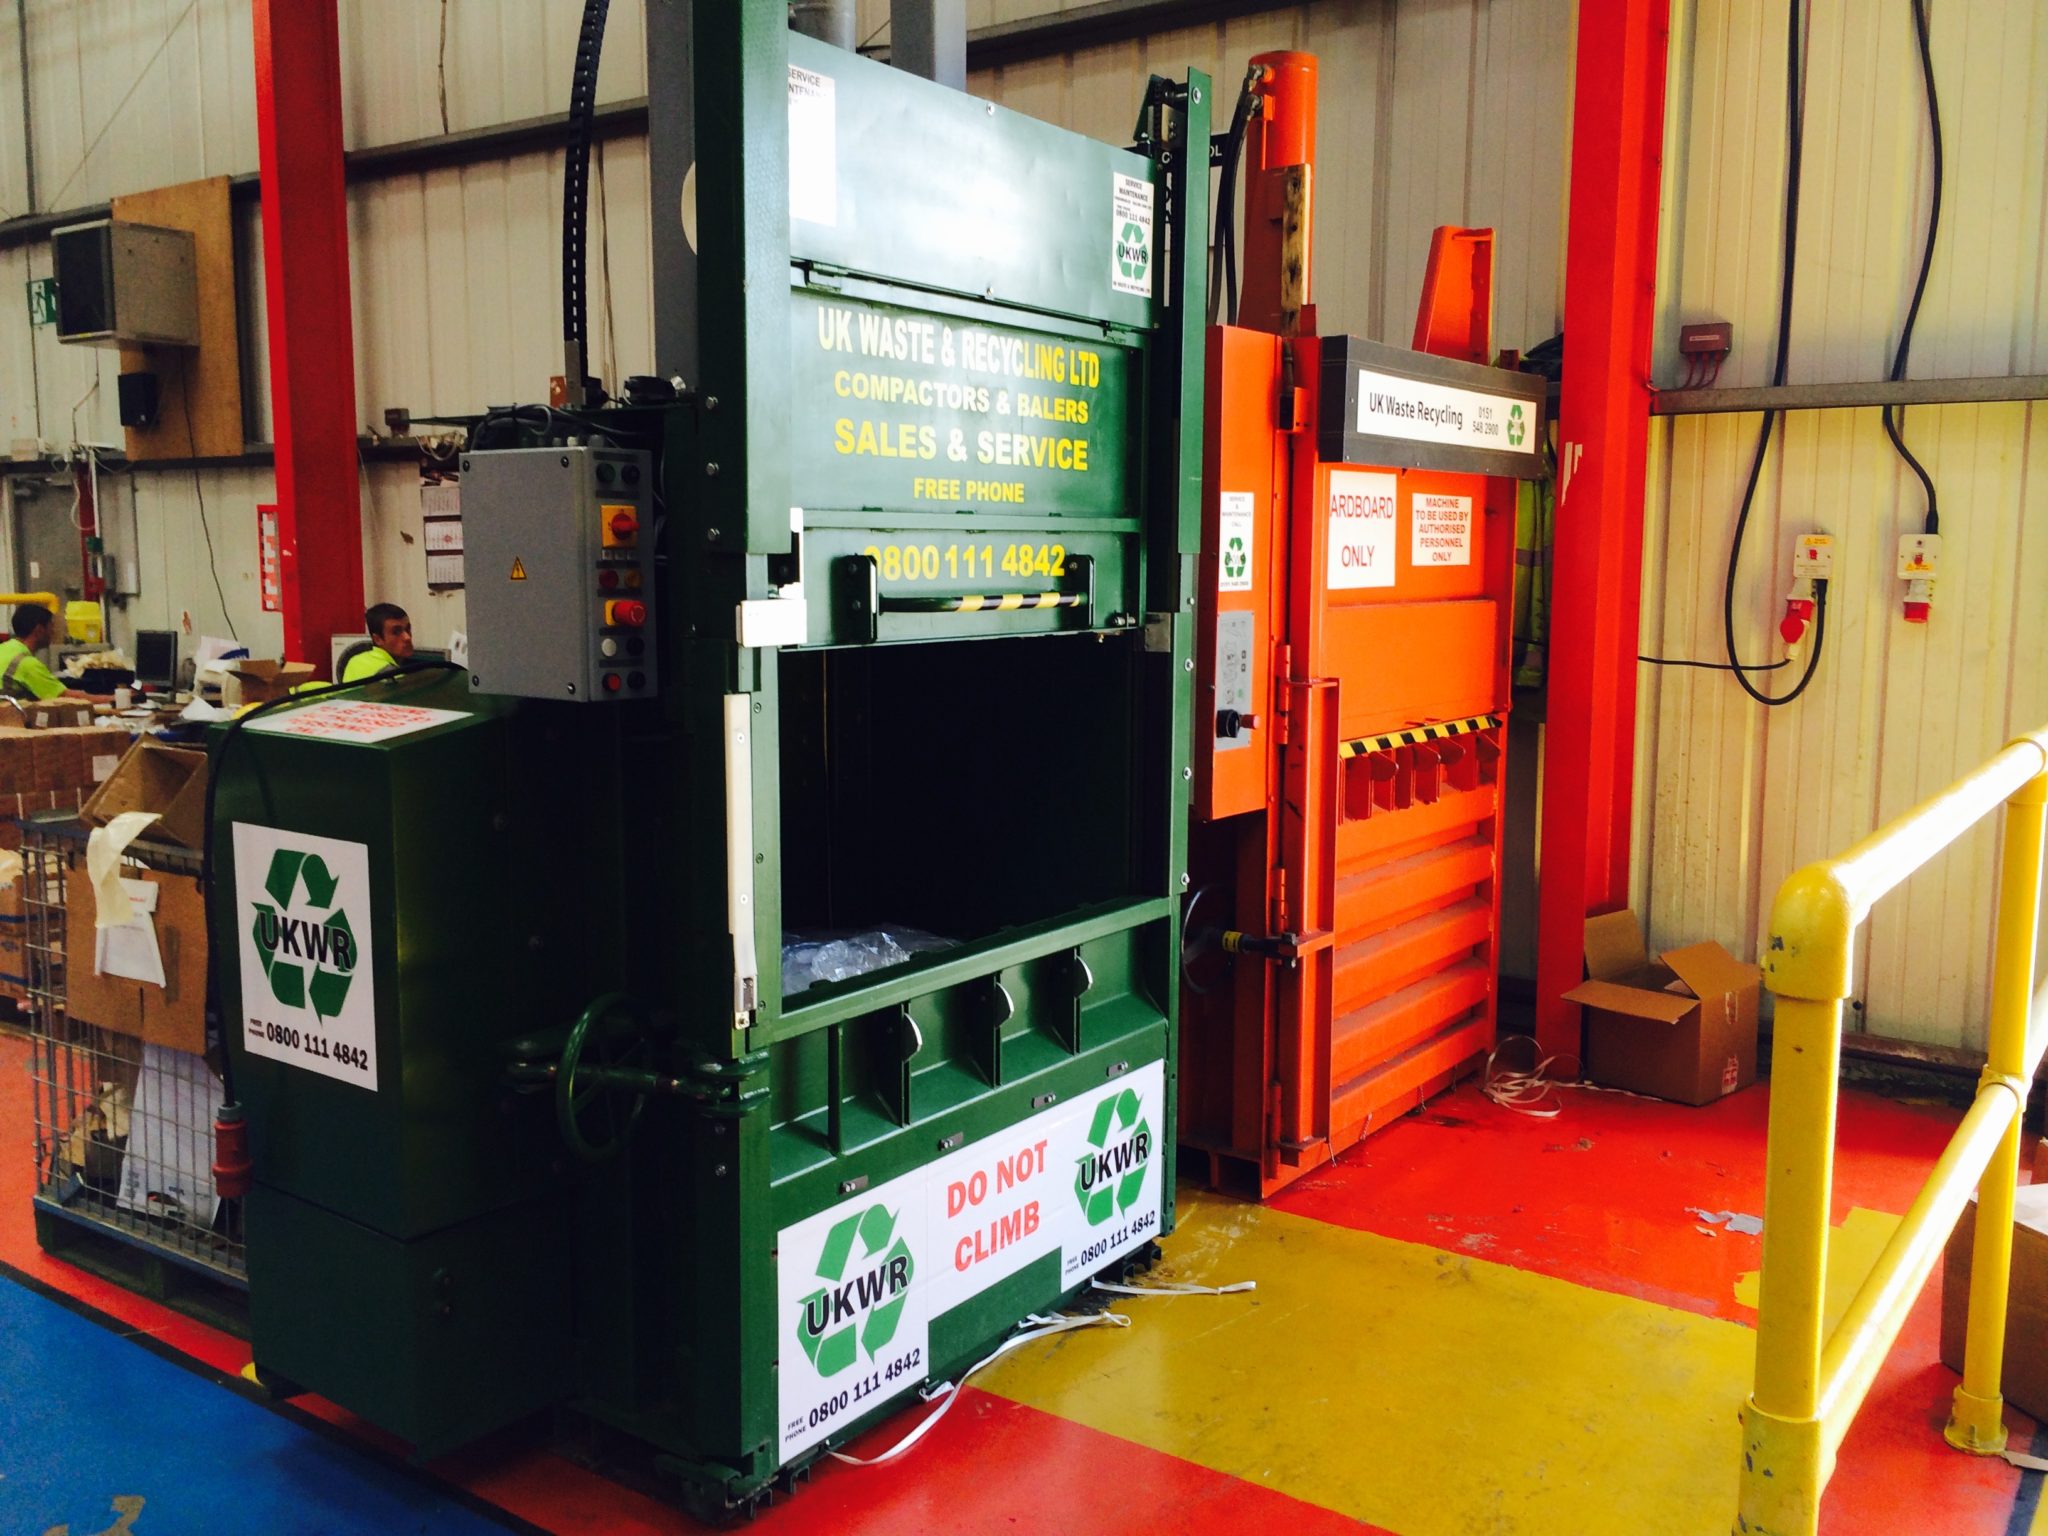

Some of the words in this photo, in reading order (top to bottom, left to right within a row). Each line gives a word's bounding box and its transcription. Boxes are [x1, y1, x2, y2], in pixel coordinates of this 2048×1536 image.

[1118, 243, 1148, 264] UKWR
[818, 306, 853, 353] UK
[858, 312, 935, 364] WASTE
[941, 326, 956, 367] &
[962, 330, 1066, 383] RECYCLING
[1069, 349, 1101, 388] LTD
[834, 370, 990, 413] COMPACTORS
[996, 388, 1011, 415] &
[1017, 393, 1089, 424] BALERS
[1369, 392, 1384, 413] UK
[1386, 395, 1415, 419] Waste
[1417, 401, 1463, 430] Recycling
[1478, 406, 1493, 420] 0151
[834, 418, 937, 460] SALES
[946, 428, 968, 462] &
[977, 430, 1089, 471] SERVICE
[913, 477, 960, 500] FREE
[966, 480, 1025, 503] PHONE
[1426, 497, 1460, 508] MACHINE
[1416, 510, 1425, 520] TO
[1427, 510, 1437, 521] BE
[1438, 510, 1458, 521] USED
[1459, 511, 1469, 521] BY
[1419, 523, 1466, 534] AUTHORISED
[1341, 545, 1375, 567] ONLY
[1420, 537, 1463, 547] PERSONNEL
[1432, 552, 1452, 561] ONLY
[944, 544, 993, 578] 111
[1001, 544, 1066, 577] 4842
[258, 911, 354, 972] UKWR
[266, 1022, 300, 1049] 0800
[304, 1033, 330, 1059] 111
[333, 1041, 368, 1071] 4842
[946, 1170, 988, 1219] DO
[996, 1139, 1048, 1194] NOT
[1079, 1131, 1149, 1191] UKWR
[954, 1200, 1040, 1273] CLIMB
[1081, 1238, 1107, 1266] 0800
[1110, 1225, 1129, 1250] 111
[1131, 1210, 1155, 1235] 4842
[806, 1255, 909, 1338] UKWR
[808, 1390, 848, 1428] 0800
[853, 1371, 881, 1402] 111
[885, 1348, 921, 1381] 4842
[784, 1425, 807, 1442] PHONE
[787, 1416, 804, 1431] FREE
